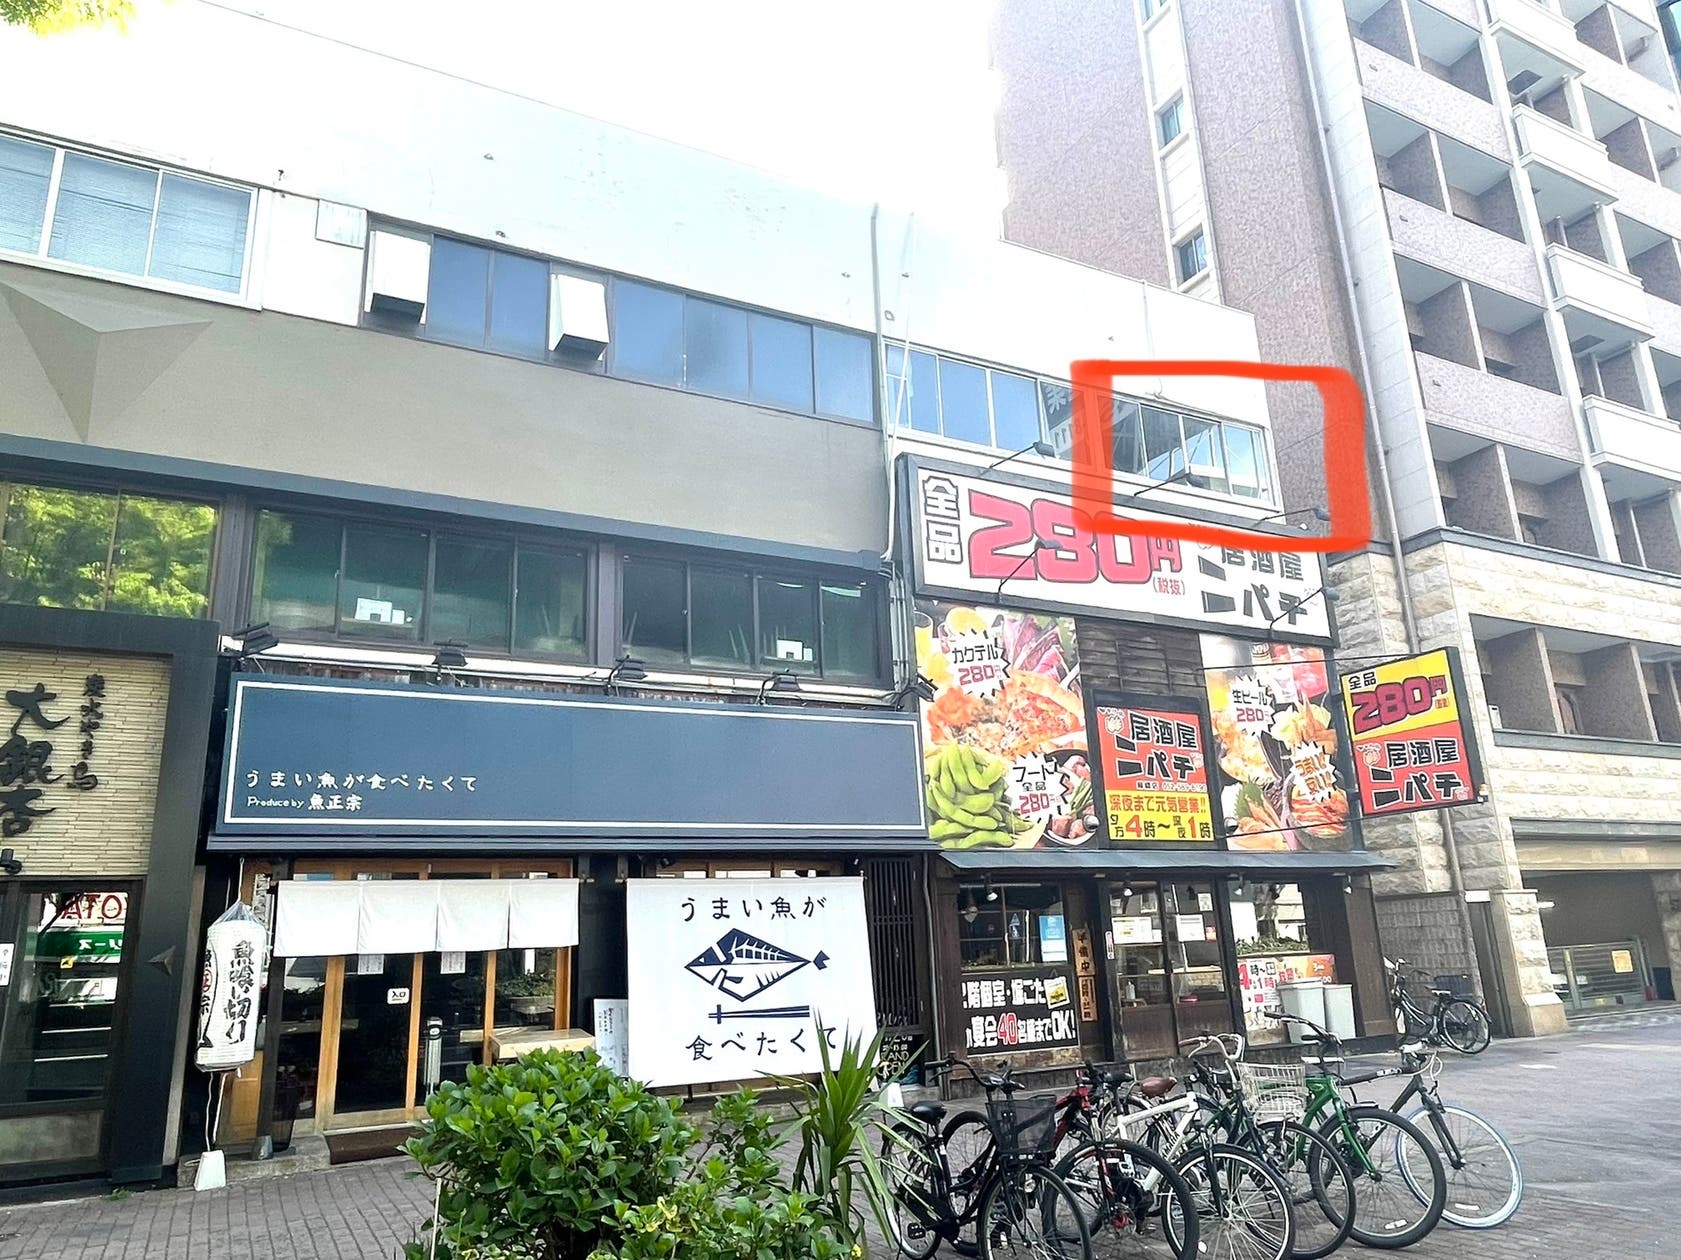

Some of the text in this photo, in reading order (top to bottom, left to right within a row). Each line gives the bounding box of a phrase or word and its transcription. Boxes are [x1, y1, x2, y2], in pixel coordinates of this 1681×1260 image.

[922, 475, 964, 564] 全品
[1197, 554, 1308, 626] ニパチ
[952, 643, 999, 664] カクテル
[1348, 671, 1377, 690] 全品
[1231, 688, 1268, 706] 生ビール
[1350, 674, 1448, 735] 280円
[1128, 710, 1198, 749] 居酒屋
[1115, 733, 1195, 780] ニパチ
[1386, 738, 1460, 768] 居酒屋
[246, 769, 479, 792] うまい魚が食べたくて
[1371, 773, 1462, 808] ニパチ
[246, 793, 363, 811] Produce by 魚正宗
[680, 896, 827, 922] うまい魚が
[391, 990, 407, 999] 入口
[685, 1026, 838, 1061] 食べたくて
